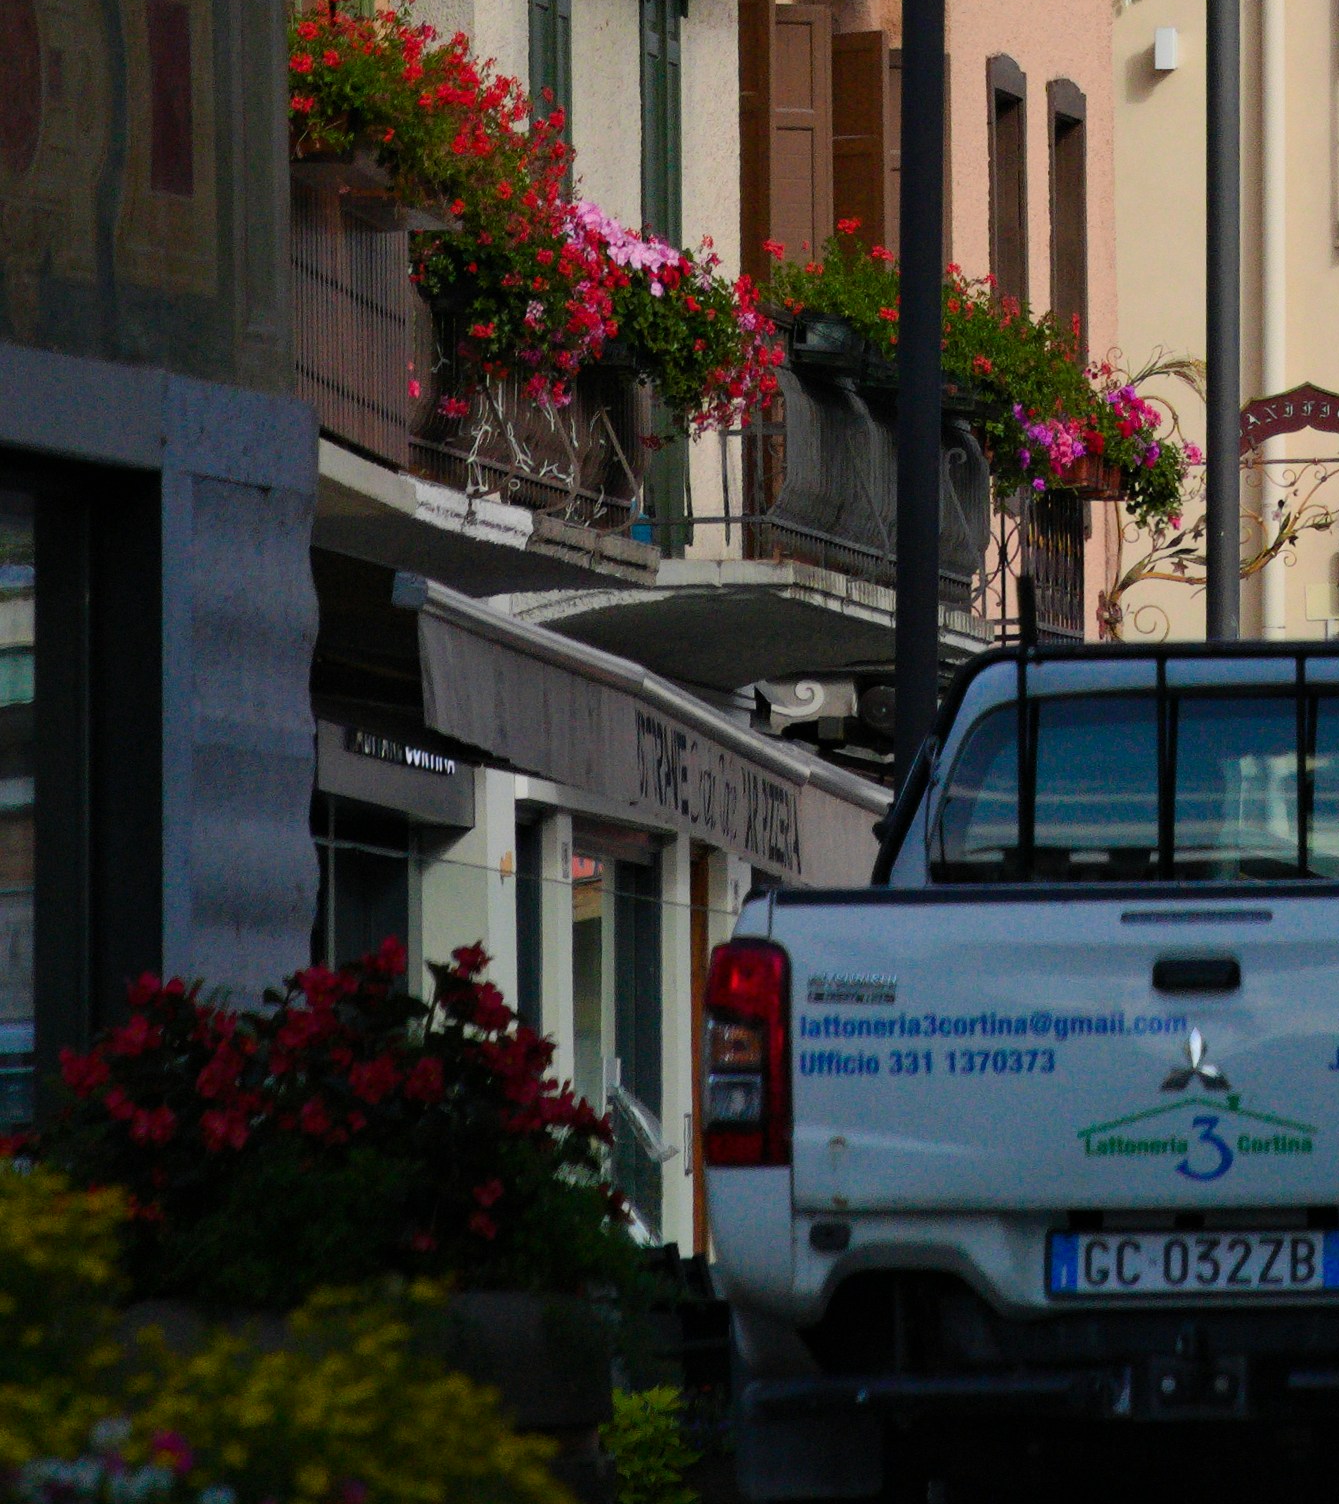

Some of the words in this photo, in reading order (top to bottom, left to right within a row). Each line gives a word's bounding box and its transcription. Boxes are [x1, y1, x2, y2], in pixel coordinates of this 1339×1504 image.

[800, 1011, 1188, 1042] lattoneria3cortina@gmail.com
[799, 1049, 879, 1075] Ufficio
[888, 1048, 933, 1075] 331
[946, 1048, 1055, 1075] 1370373
[1084, 1135, 1188, 1158] Lattoneria
[1175, 1115, 1234, 1182] 3
[1236, 1134, 1313, 1157] Cortina
[1084, 1239, 1141, 1286] GC
[1163, 1238, 1316, 1286] 032ZB
